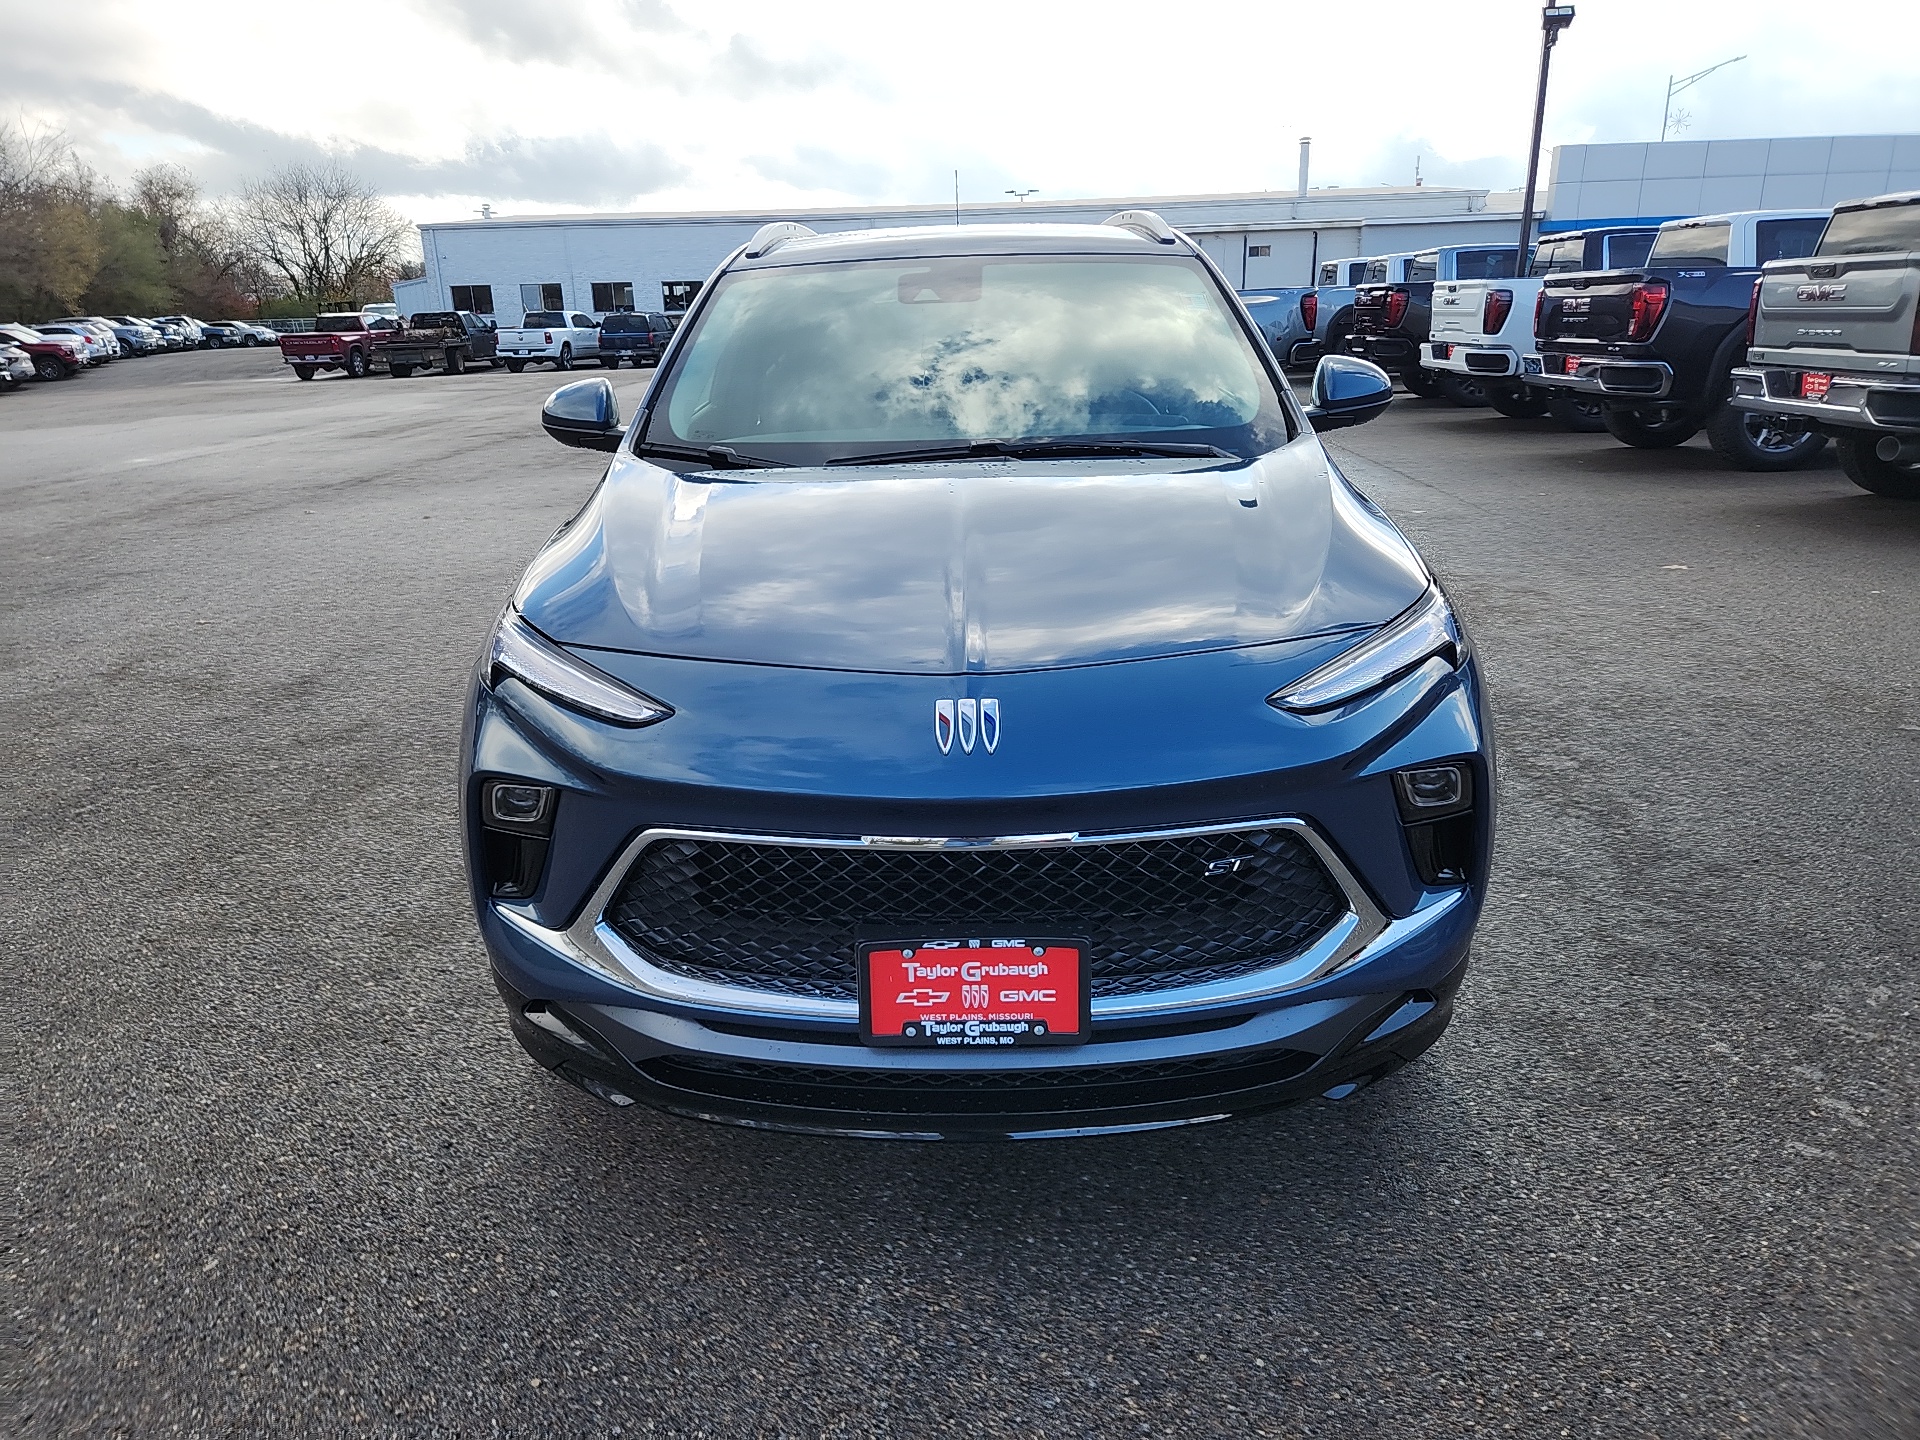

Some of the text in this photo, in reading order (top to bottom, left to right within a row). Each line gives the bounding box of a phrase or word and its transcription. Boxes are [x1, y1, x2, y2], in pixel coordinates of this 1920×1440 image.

[1797, 284, 1847, 301] GMC
[1204, 854, 1254, 876] ST
[991, 939, 1026, 948] GMC
[902, 961, 1048, 983] Taylor Grubaugh
[999, 989, 1056, 1002] GMC
[920, 1013, 946, 1021] WEST
[988, 1012, 1034, 1021] MISSOURI
[921, 1020, 1029, 1037] Taylor Grubaugh
[936, 1036, 1015, 1046] WEST PLAINS, MO
